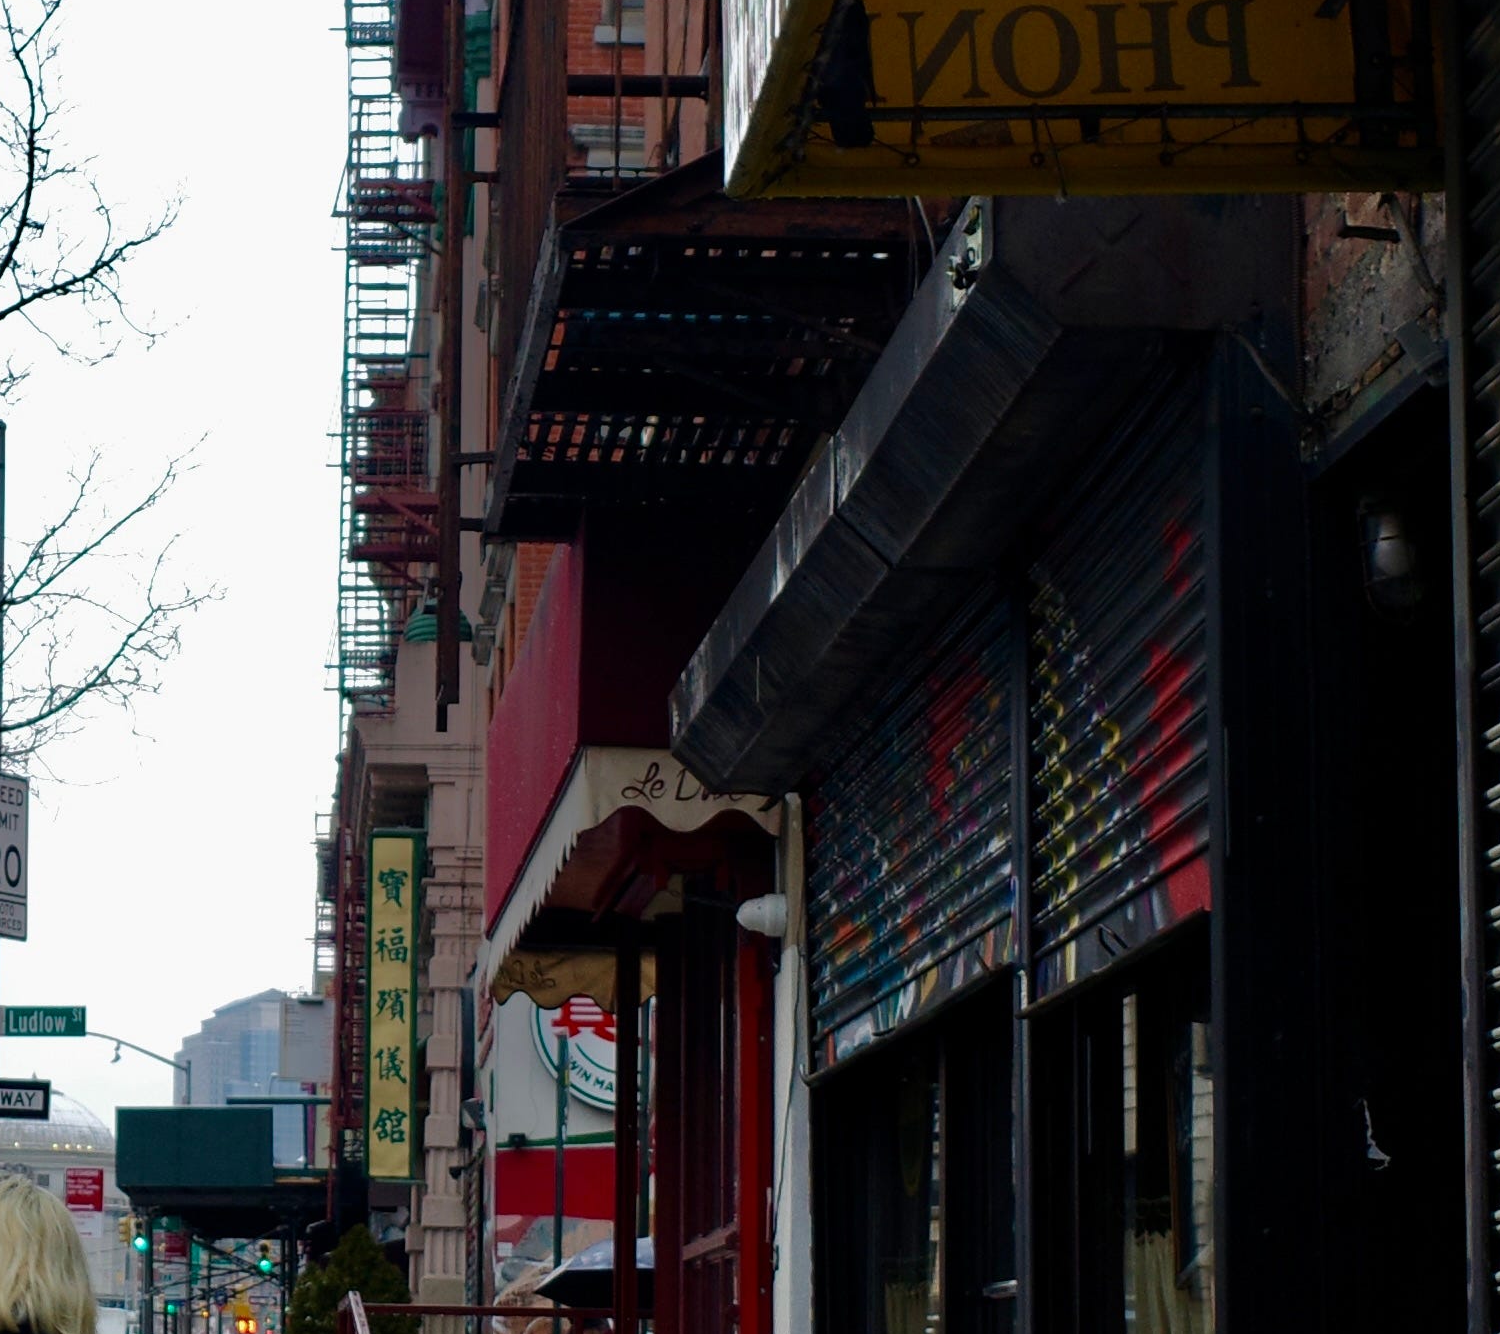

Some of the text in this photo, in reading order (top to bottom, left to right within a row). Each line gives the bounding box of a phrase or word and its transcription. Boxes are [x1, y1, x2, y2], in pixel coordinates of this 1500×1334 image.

[621, 761, 668, 803] Le
[8, 1010, 67, 1034] Ludlow
[0, 1091, 36, 1107] WAY
